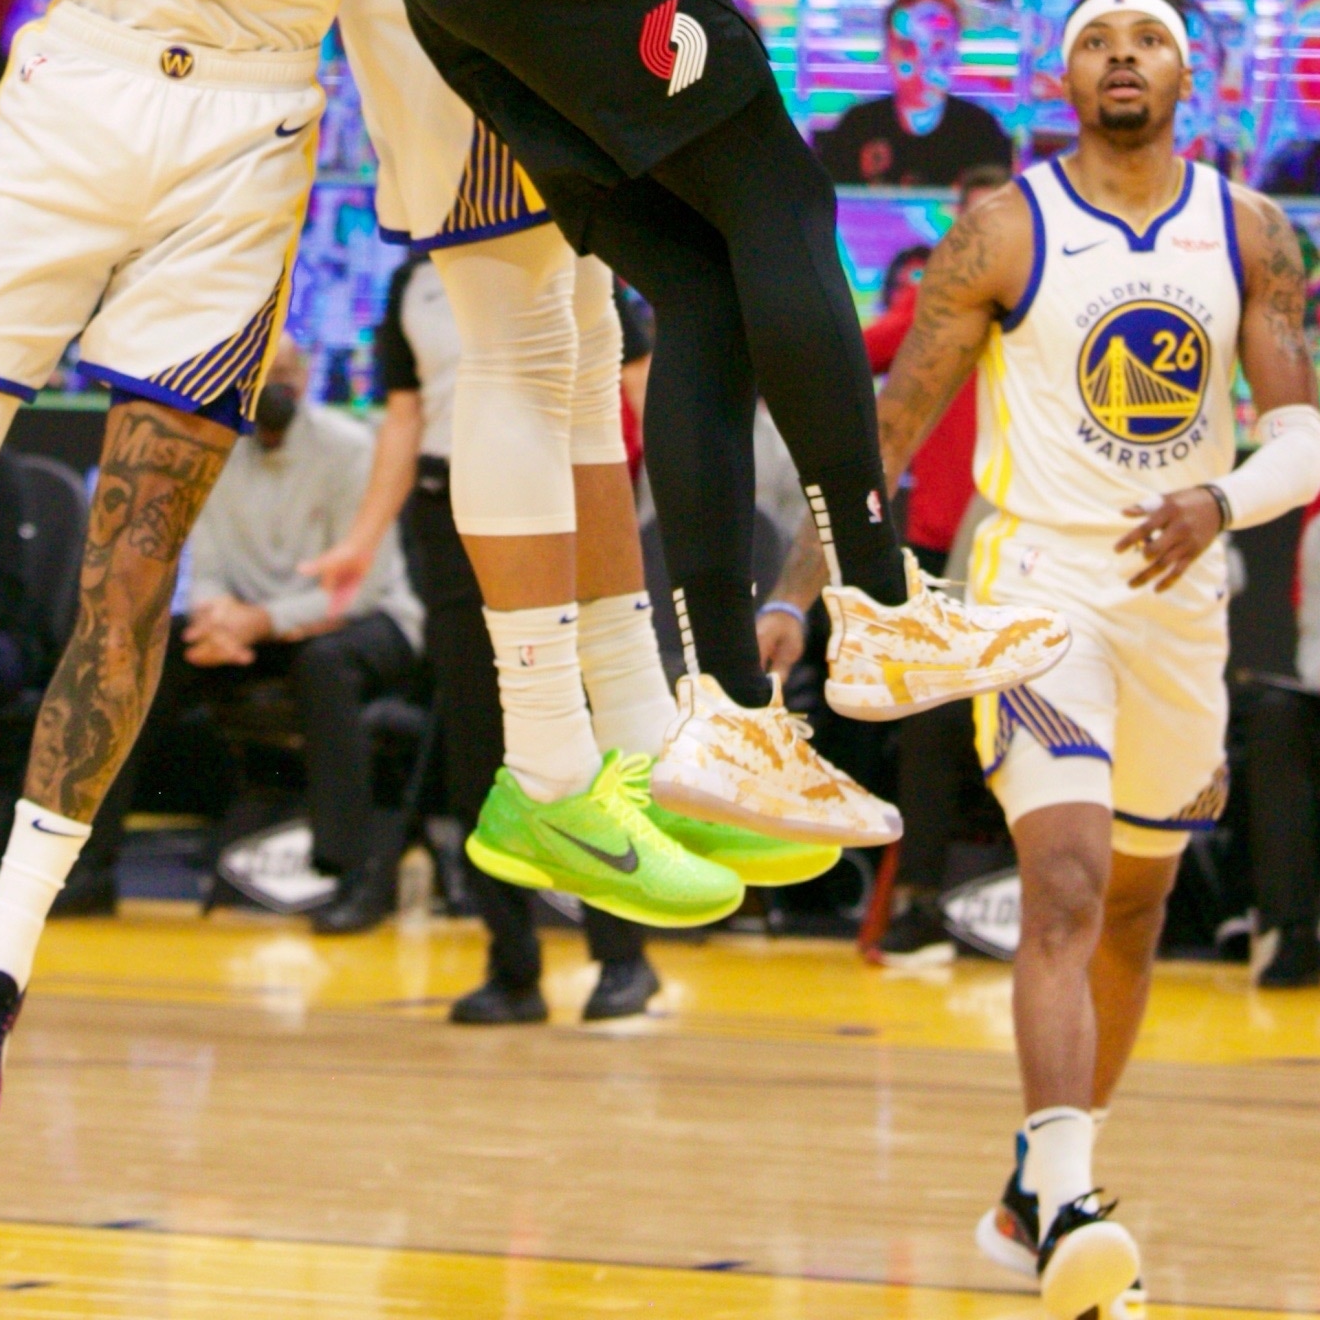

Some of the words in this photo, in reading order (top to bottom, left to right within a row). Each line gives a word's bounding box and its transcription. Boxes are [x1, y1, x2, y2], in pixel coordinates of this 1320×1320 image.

[1075, 282, 1151, 330] GOLDEN
[1162, 283, 1213, 326] STATE
[1152, 330, 1198, 371] 26
